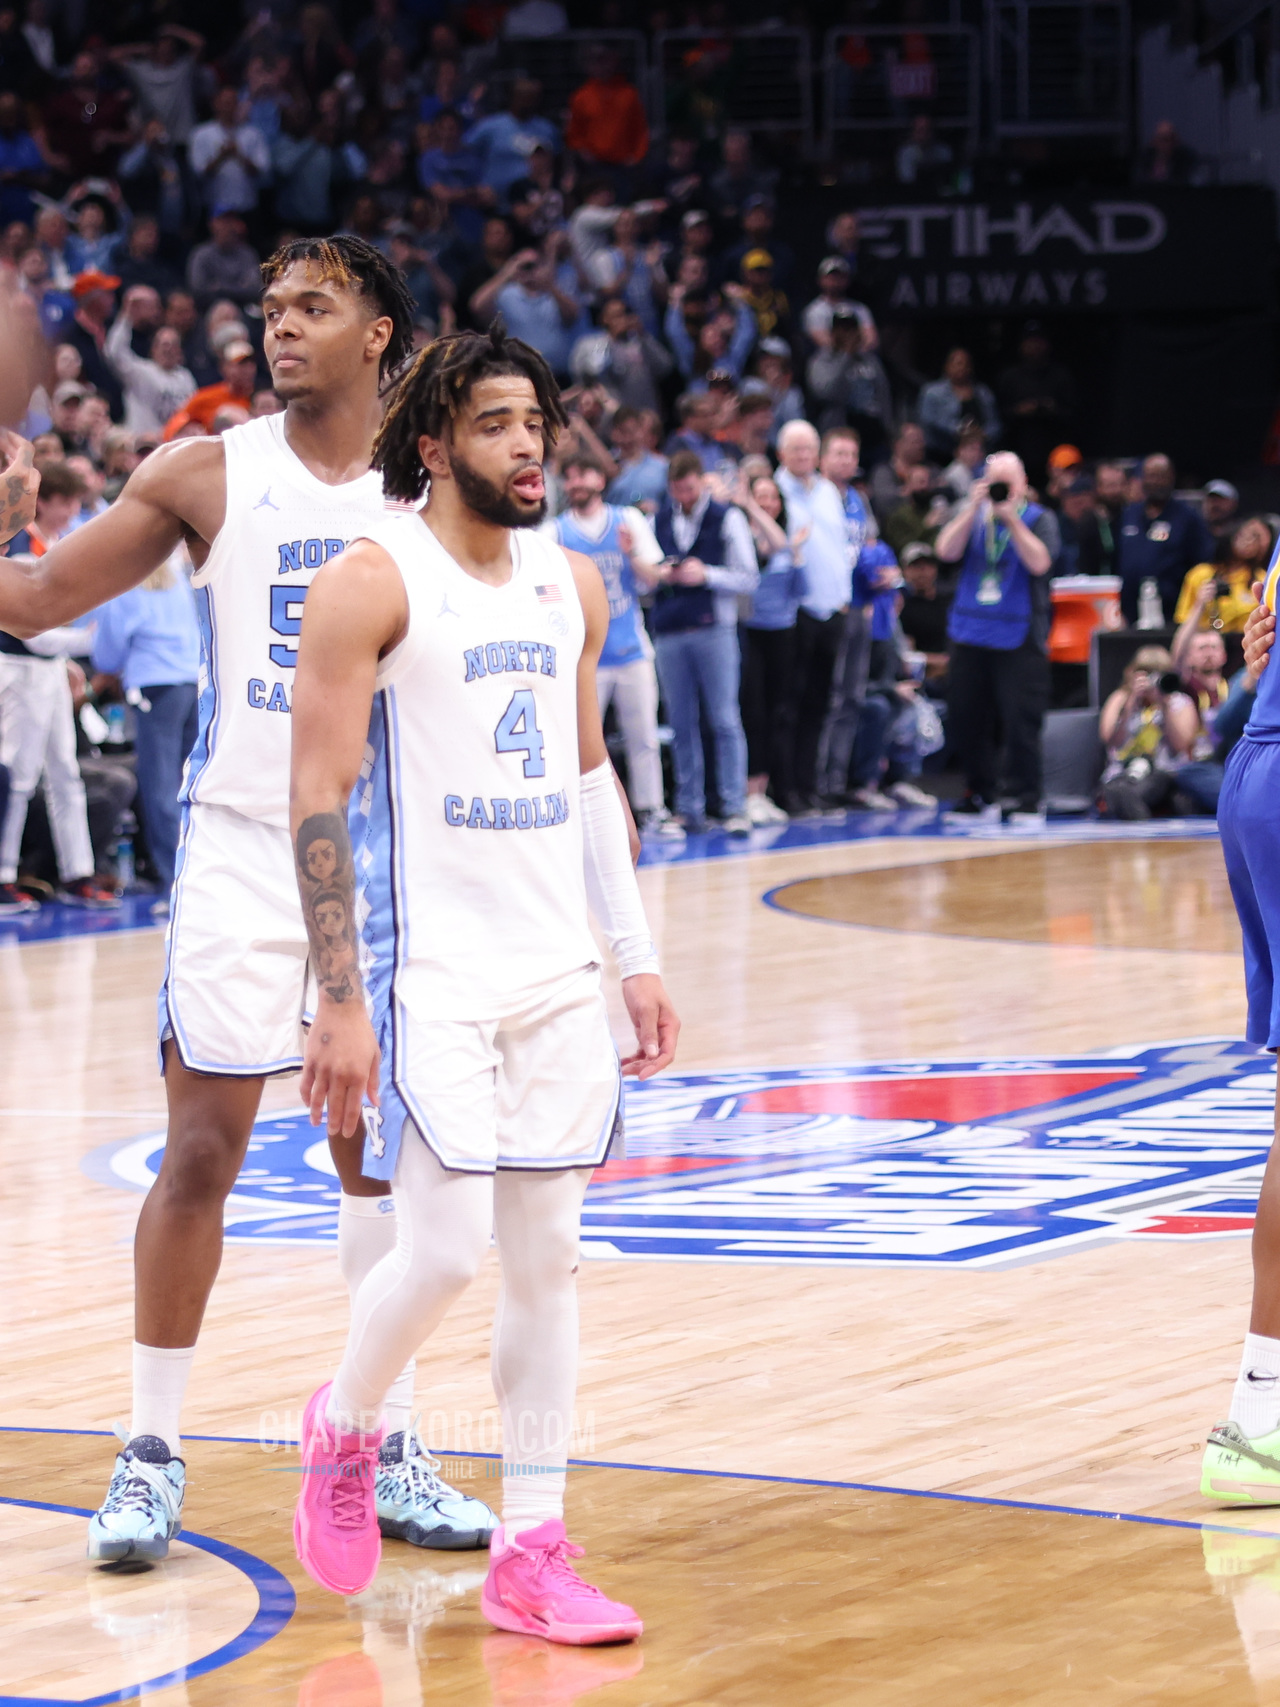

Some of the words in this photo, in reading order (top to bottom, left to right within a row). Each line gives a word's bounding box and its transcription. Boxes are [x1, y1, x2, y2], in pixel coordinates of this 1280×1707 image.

[828, 203, 1167, 259] ETIHAD
[889, 270, 1107, 306] AIRWAYS
[278, 538, 350, 575] NOR
[464, 641, 556, 682] NORTH
[494, 689, 545, 778] 4
